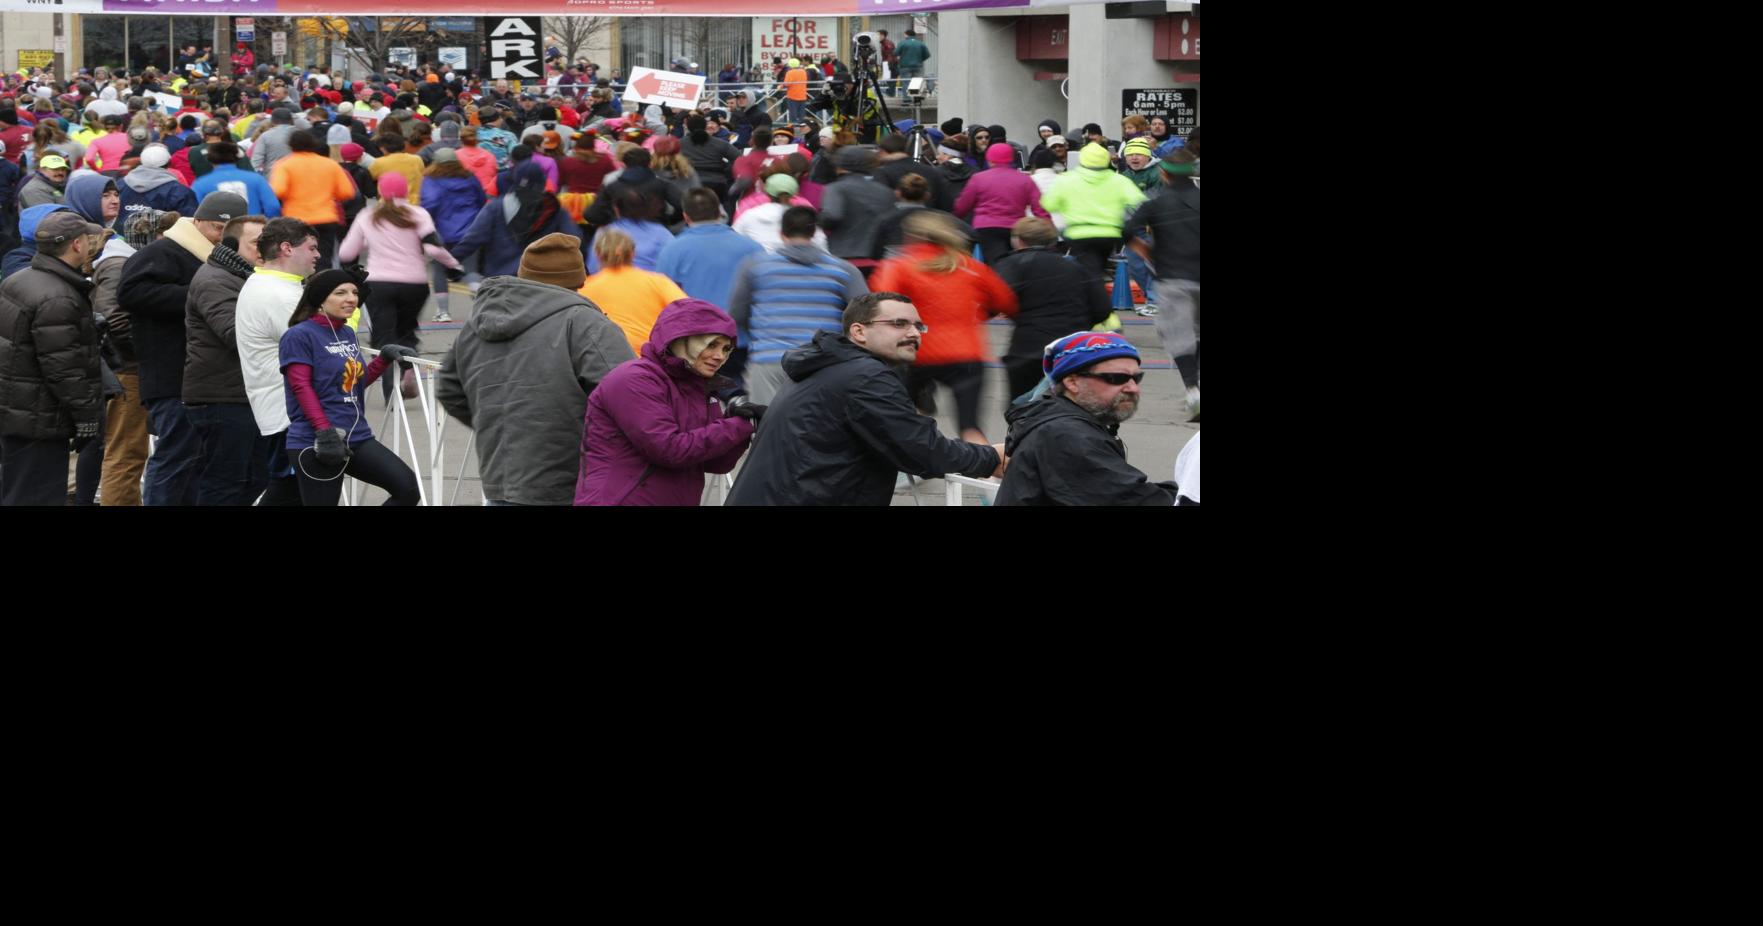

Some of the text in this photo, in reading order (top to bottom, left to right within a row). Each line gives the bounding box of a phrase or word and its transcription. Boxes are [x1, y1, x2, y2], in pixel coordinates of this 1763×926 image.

[771, 19, 816, 33] FOR
[761, 34, 829, 49] LEASE
[1136, 93, 1183, 101] RATES
[1125, 108, 1136, 116] Each
